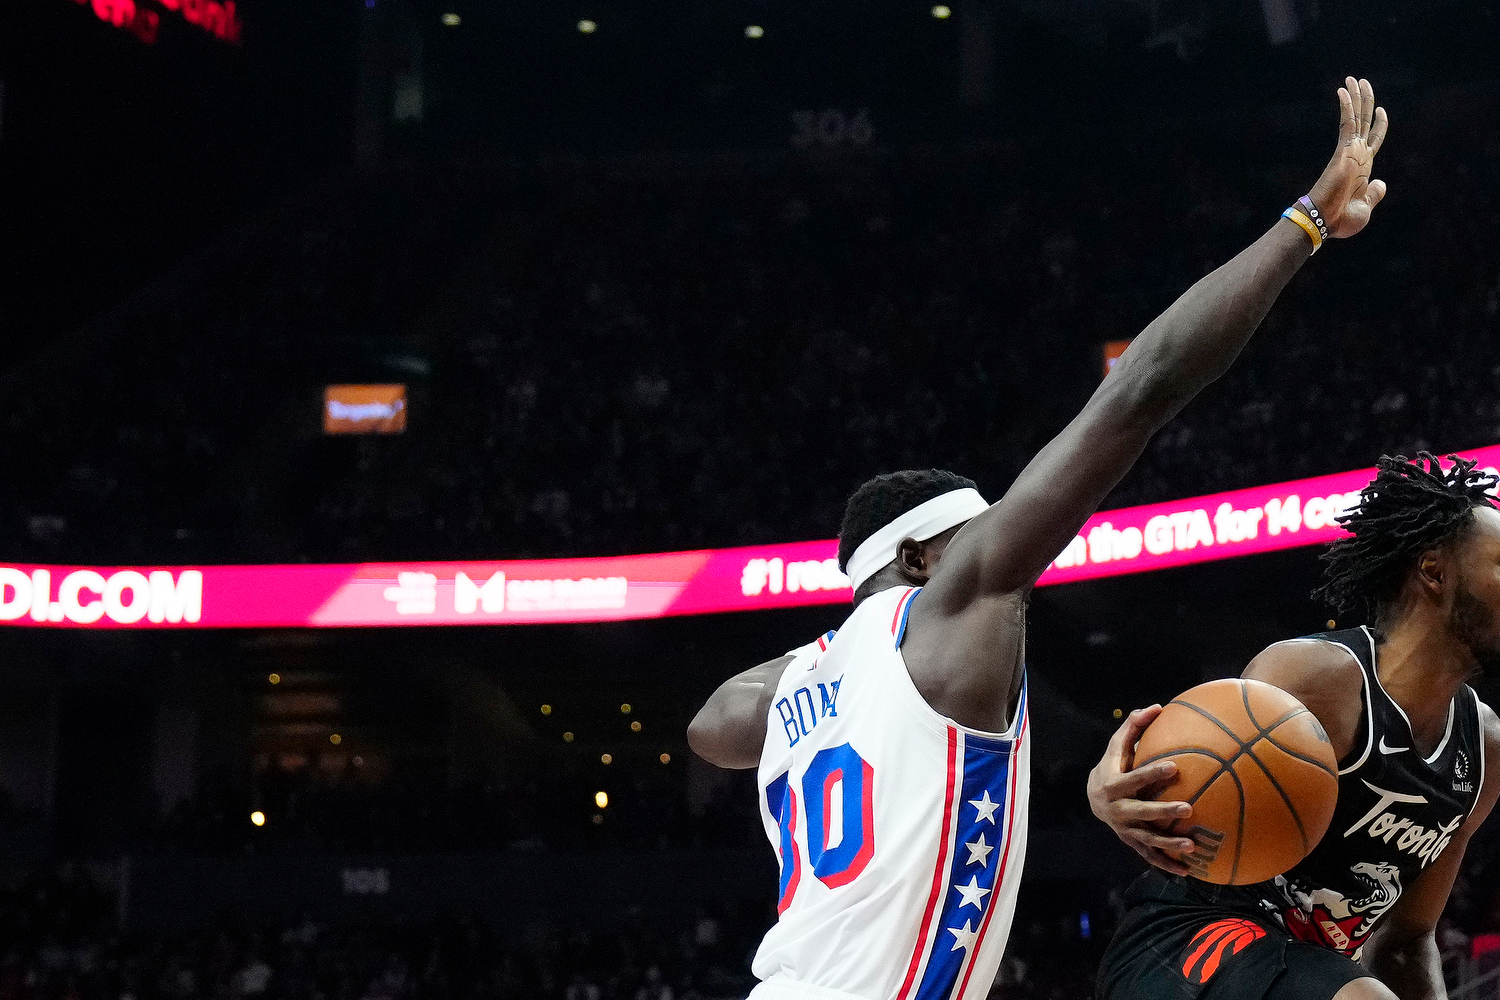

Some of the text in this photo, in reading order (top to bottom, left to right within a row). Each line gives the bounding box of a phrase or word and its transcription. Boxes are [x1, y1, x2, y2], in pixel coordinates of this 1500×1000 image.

[1087, 522, 1143, 563] the
[1144, 508, 1214, 555] GTA
[1214, 501, 1262, 544] for
[1264, 494, 1301, 536] 14
[1344, 778, 1463, 869] Toronto
